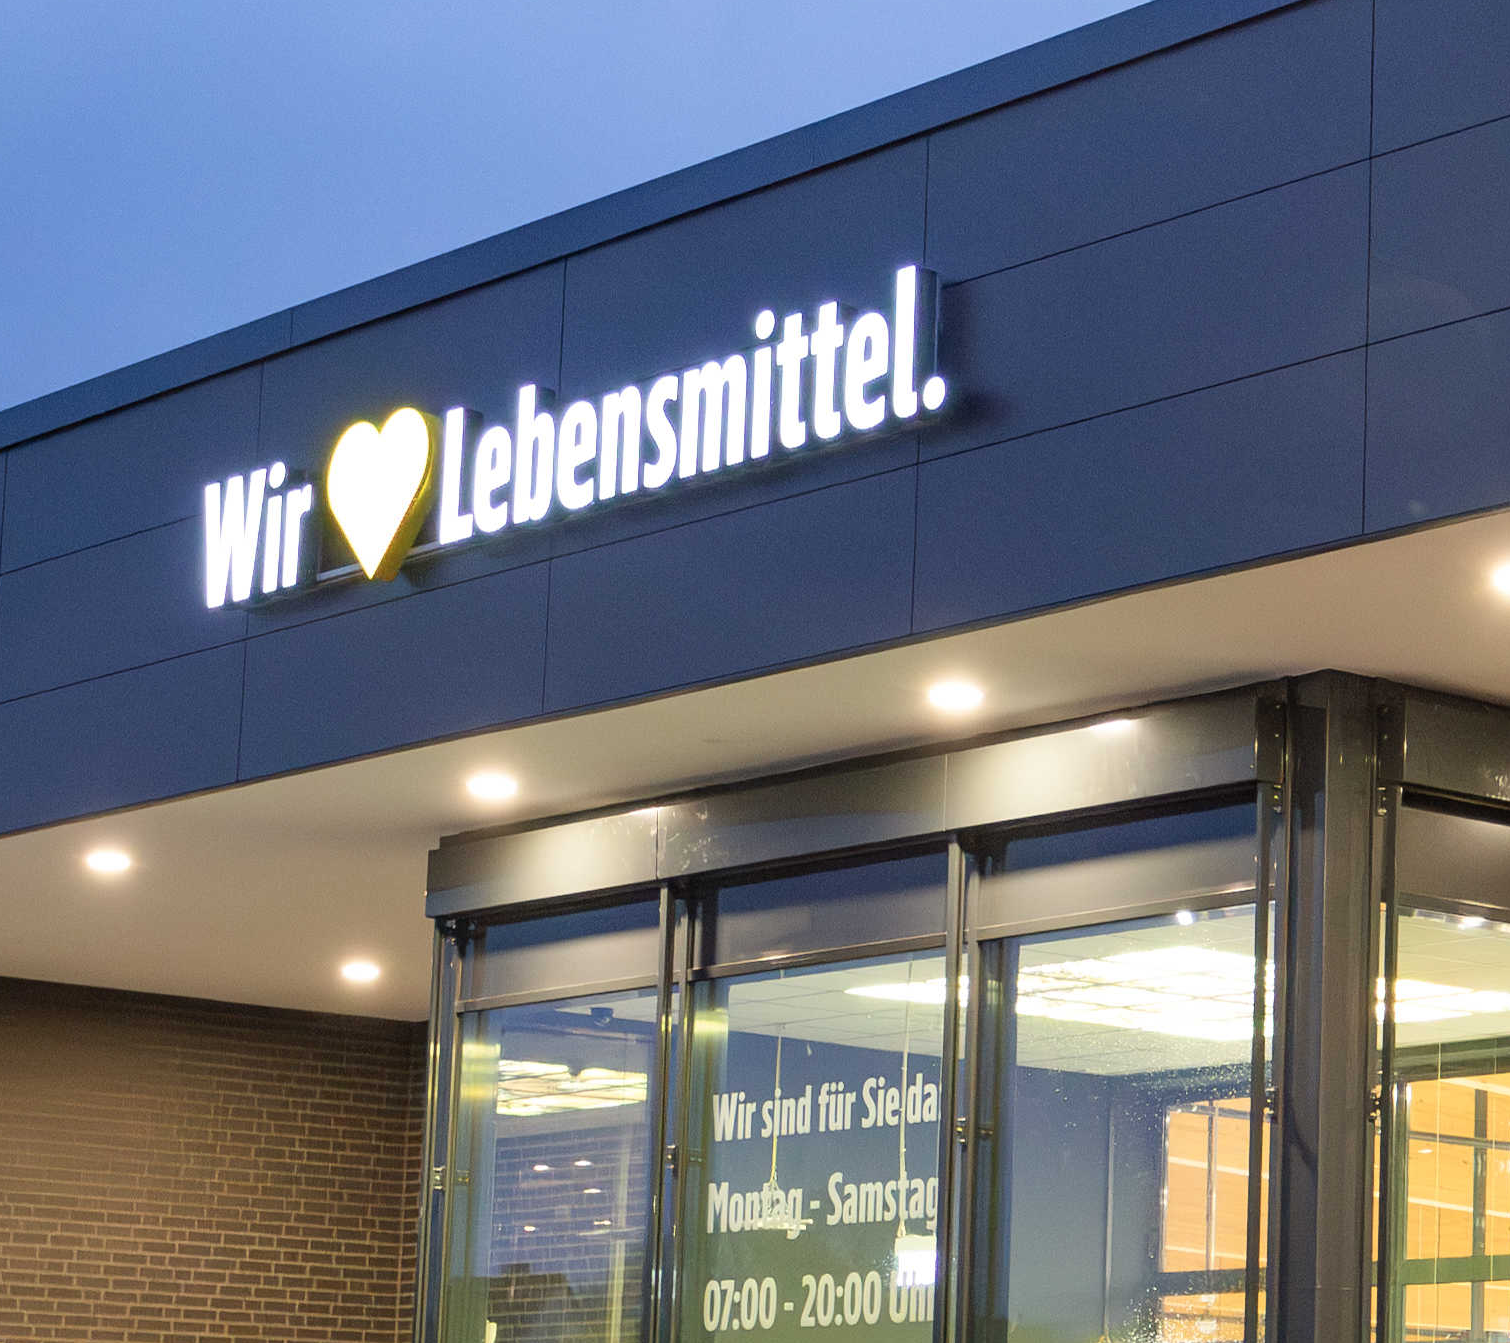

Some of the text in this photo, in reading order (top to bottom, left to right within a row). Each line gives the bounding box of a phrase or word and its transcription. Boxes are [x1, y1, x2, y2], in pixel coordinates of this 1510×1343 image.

[204, 264, 948, 610] Wir Lebensmittel.
[712, 1073, 941, 1142] Wir sind für Sie da
[706, 1172, 939, 1240] Montag - Samstag
[703, 1276, 778, 1332] 07:00
[784, 1301, 795, 1311] -
[800, 1270, 883, 1327] 20:00
